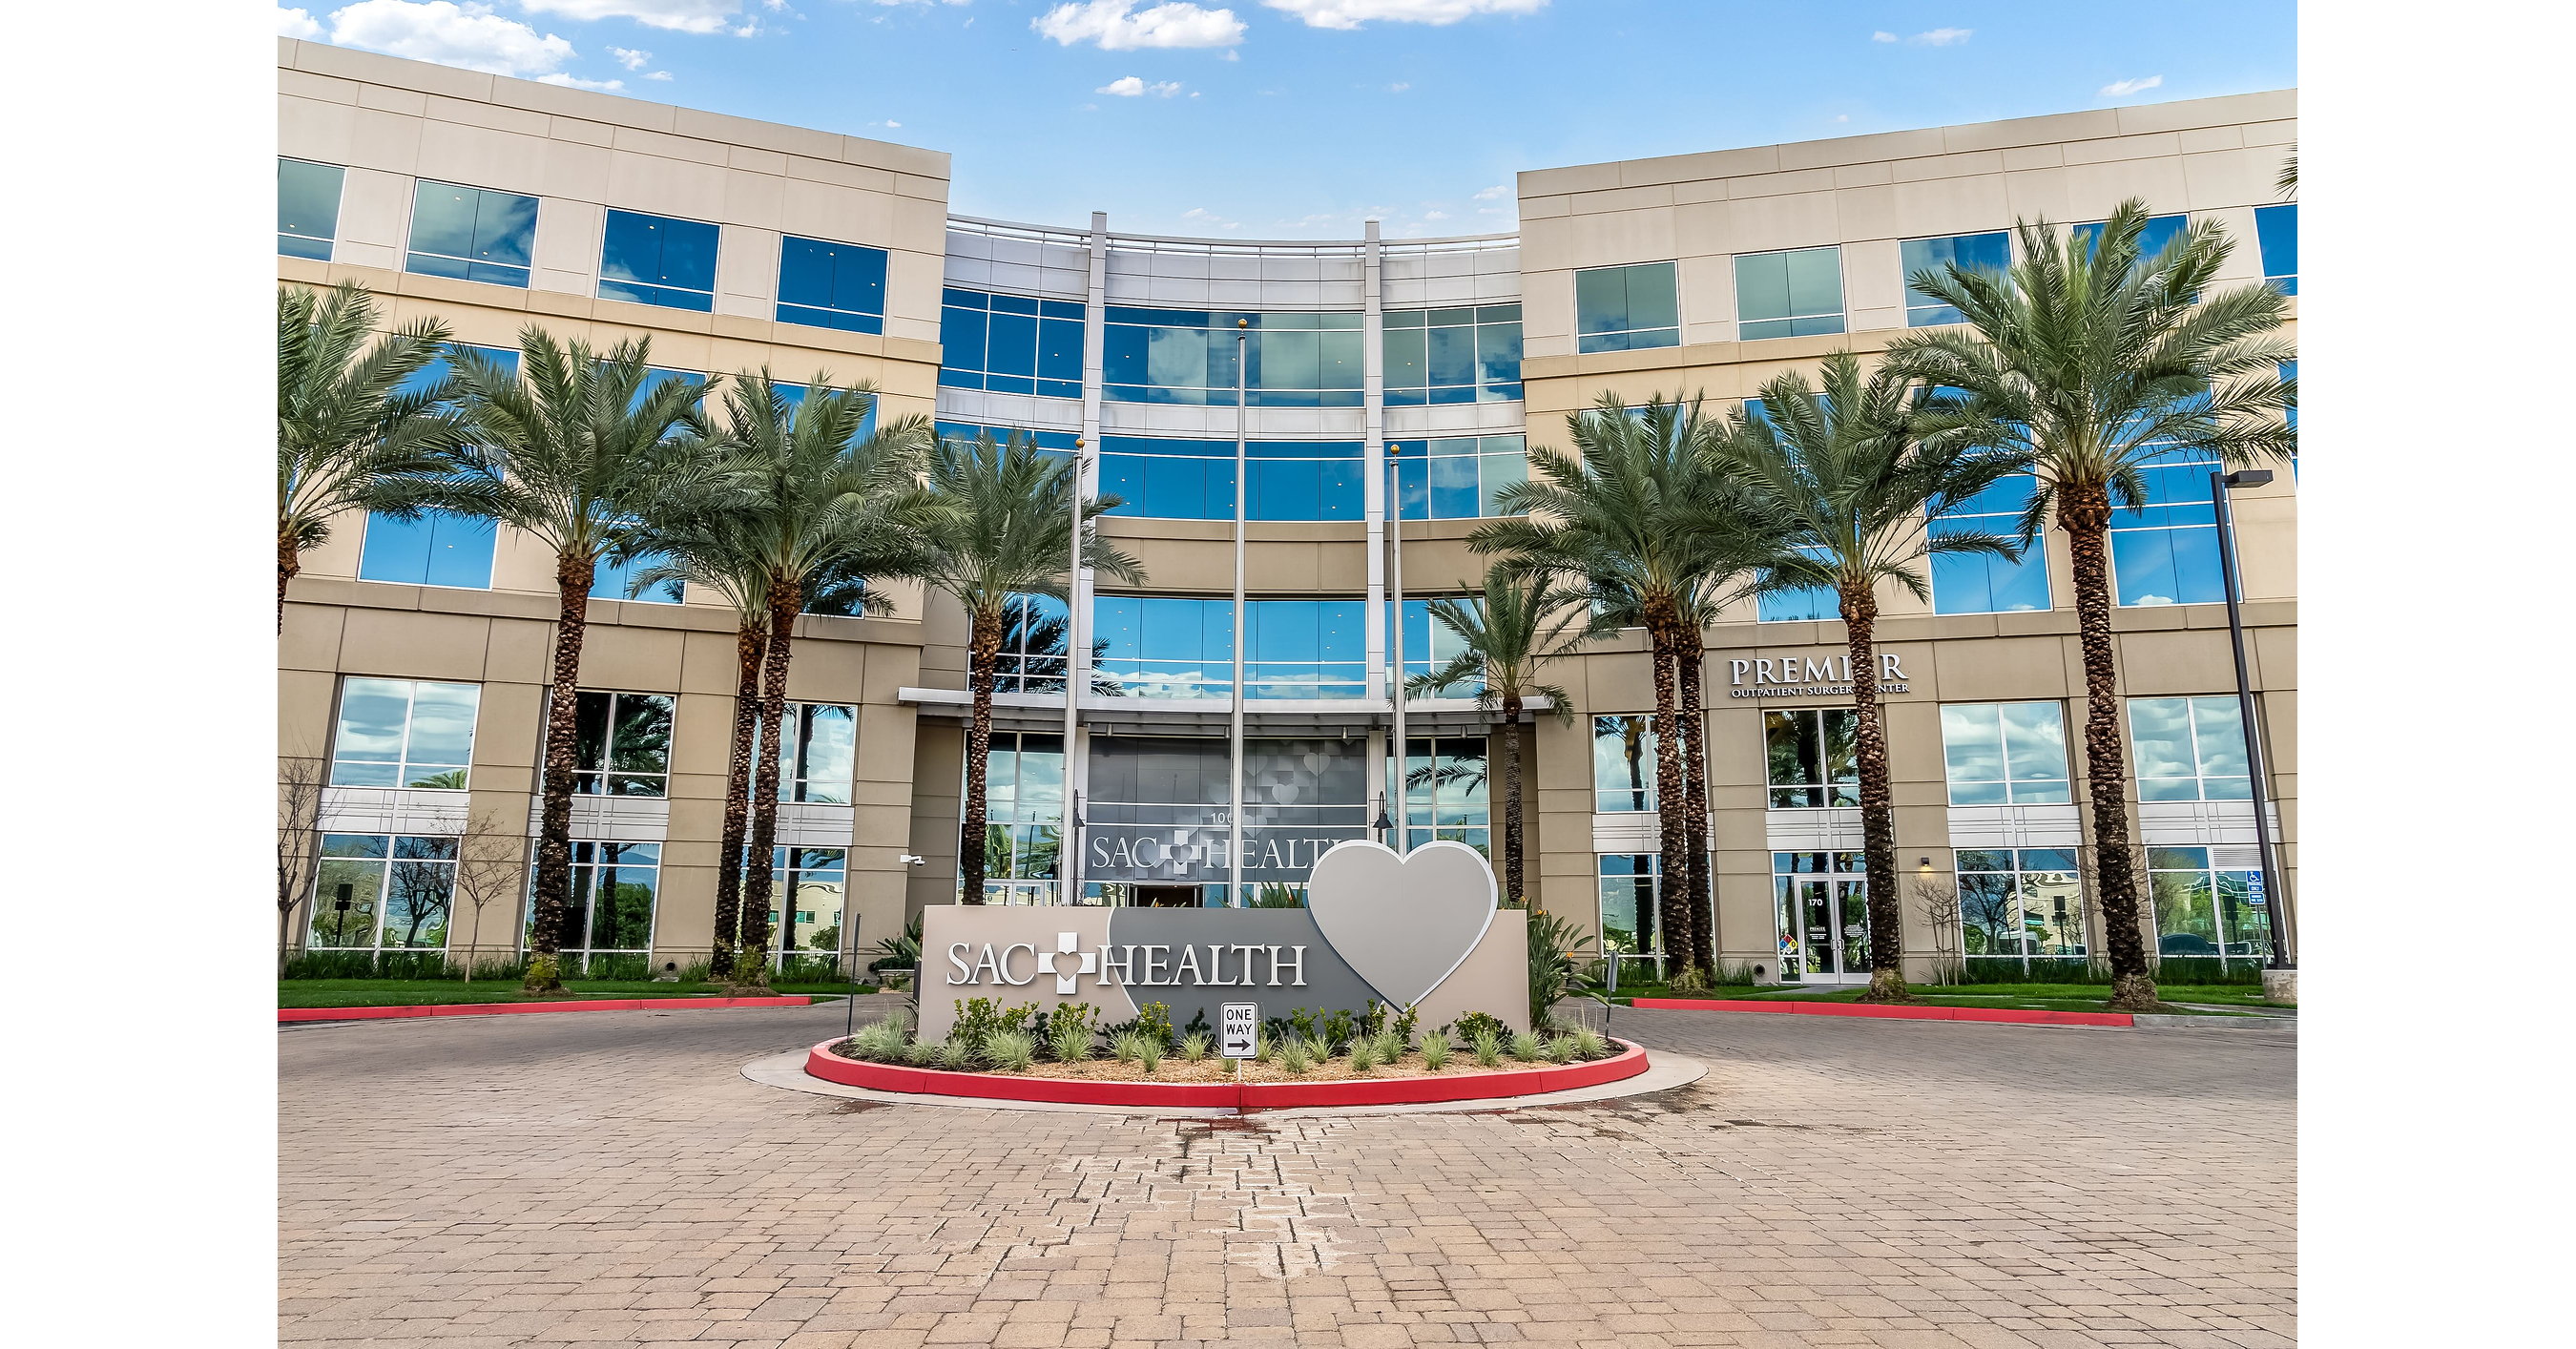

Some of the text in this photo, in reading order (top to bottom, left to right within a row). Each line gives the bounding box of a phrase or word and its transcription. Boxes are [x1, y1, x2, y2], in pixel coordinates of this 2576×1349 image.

[1730, 654, 1909, 685] PREMIR
[1732, 683, 1910, 698] OUTPATIENT SURGER ENTER
[1091, 836, 1343, 869] SAC HEALT
[946, 941, 1308, 986] SAC HEALTH
[1226, 1008, 1252, 1021] ONE
[1226, 1023, 1253, 1035] WAY
